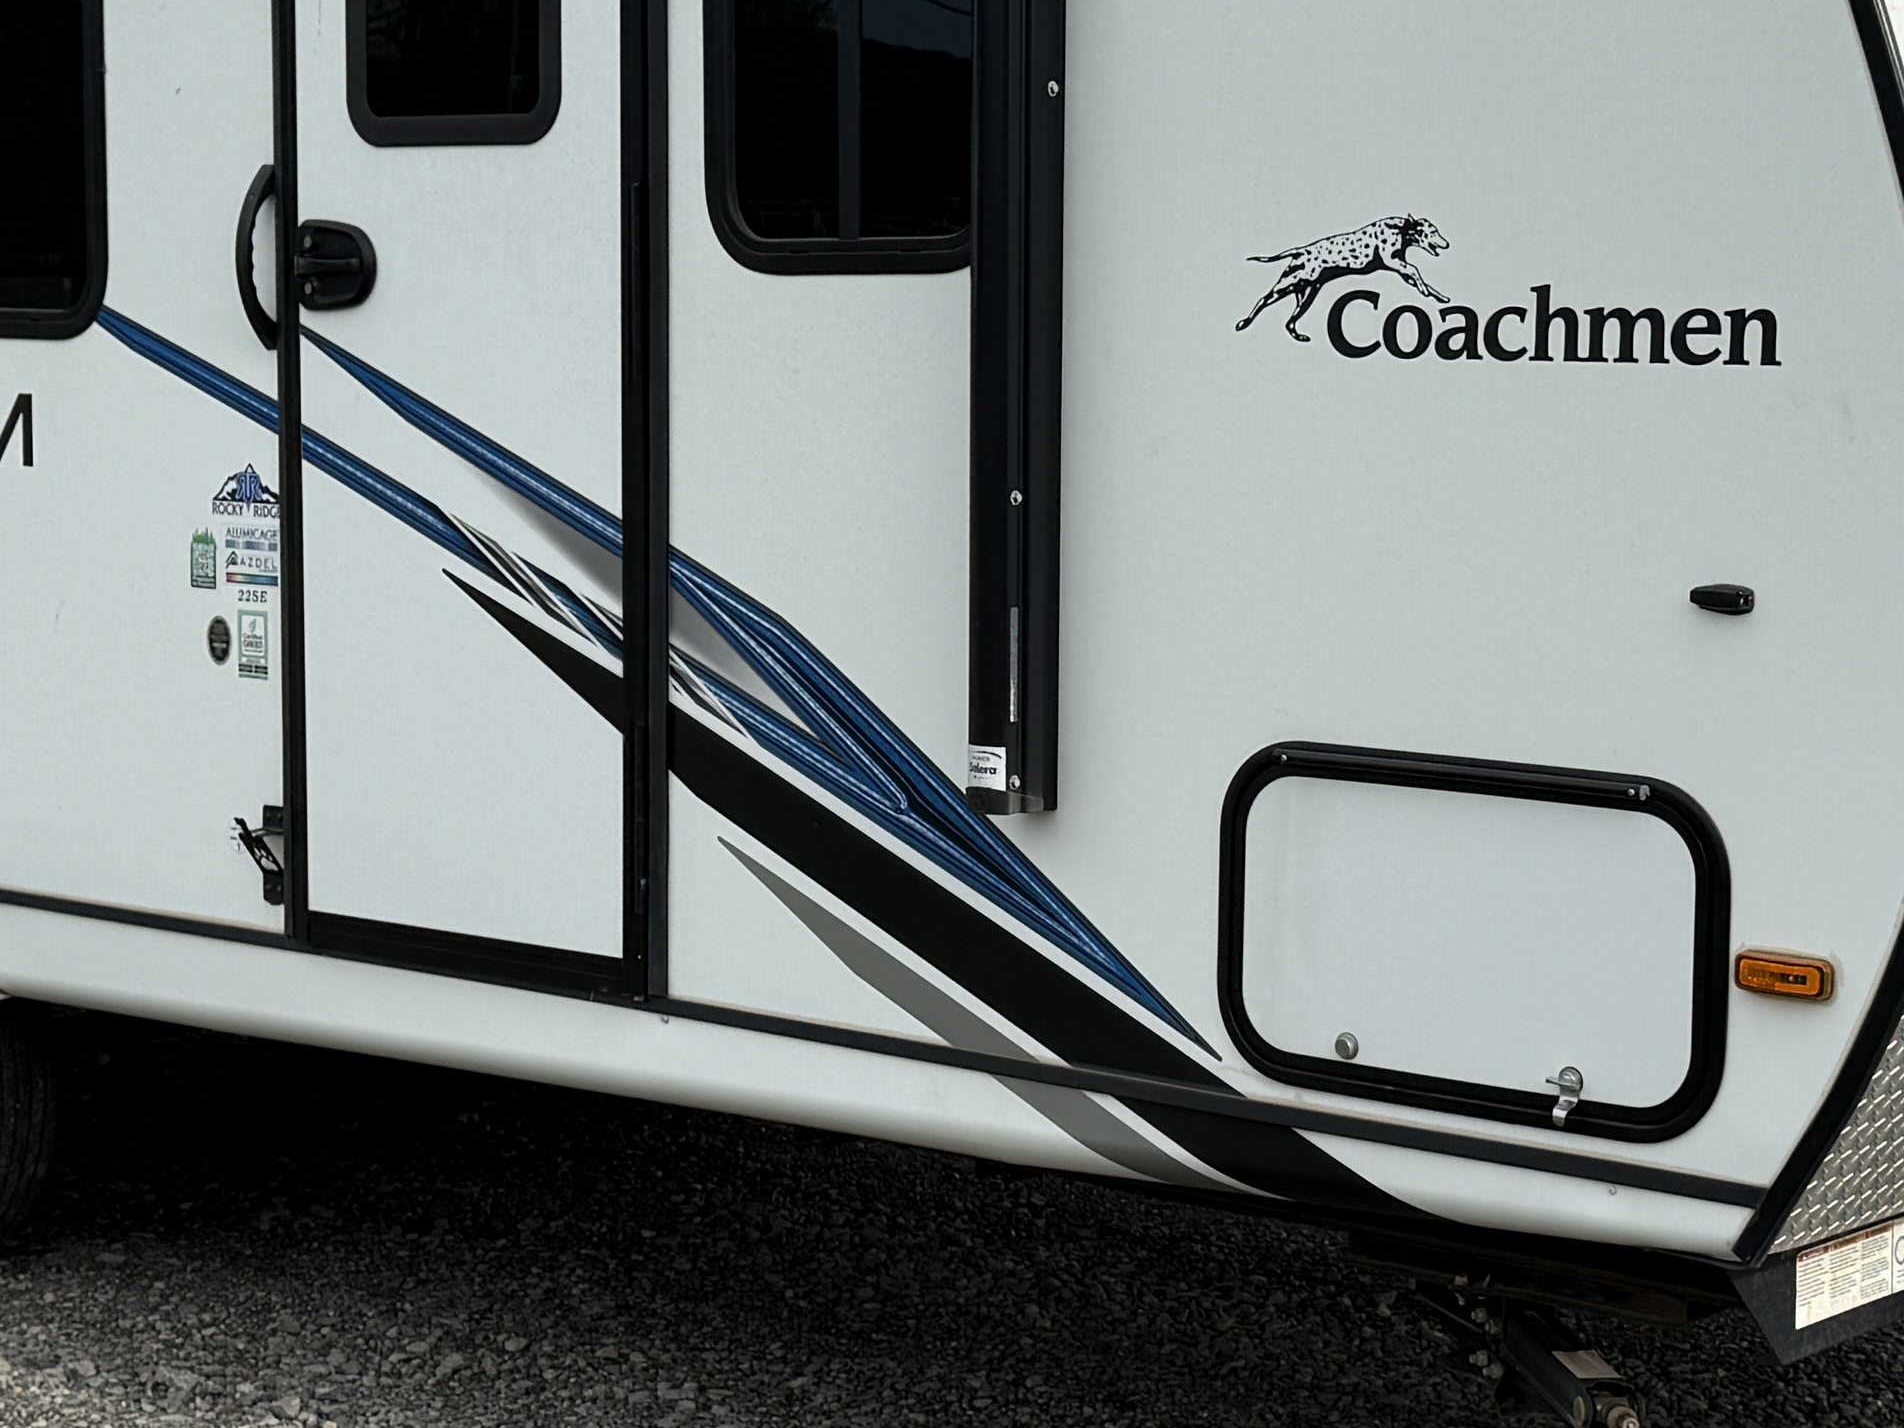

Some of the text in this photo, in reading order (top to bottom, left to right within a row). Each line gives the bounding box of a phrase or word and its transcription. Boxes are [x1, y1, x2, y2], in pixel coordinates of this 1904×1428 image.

[1325, 283, 1783, 367] Coachmen
[211, 501, 244, 516] ROCKY
[240, 556, 278, 568] AZDEL
[237, 589, 268, 603] 22SE
